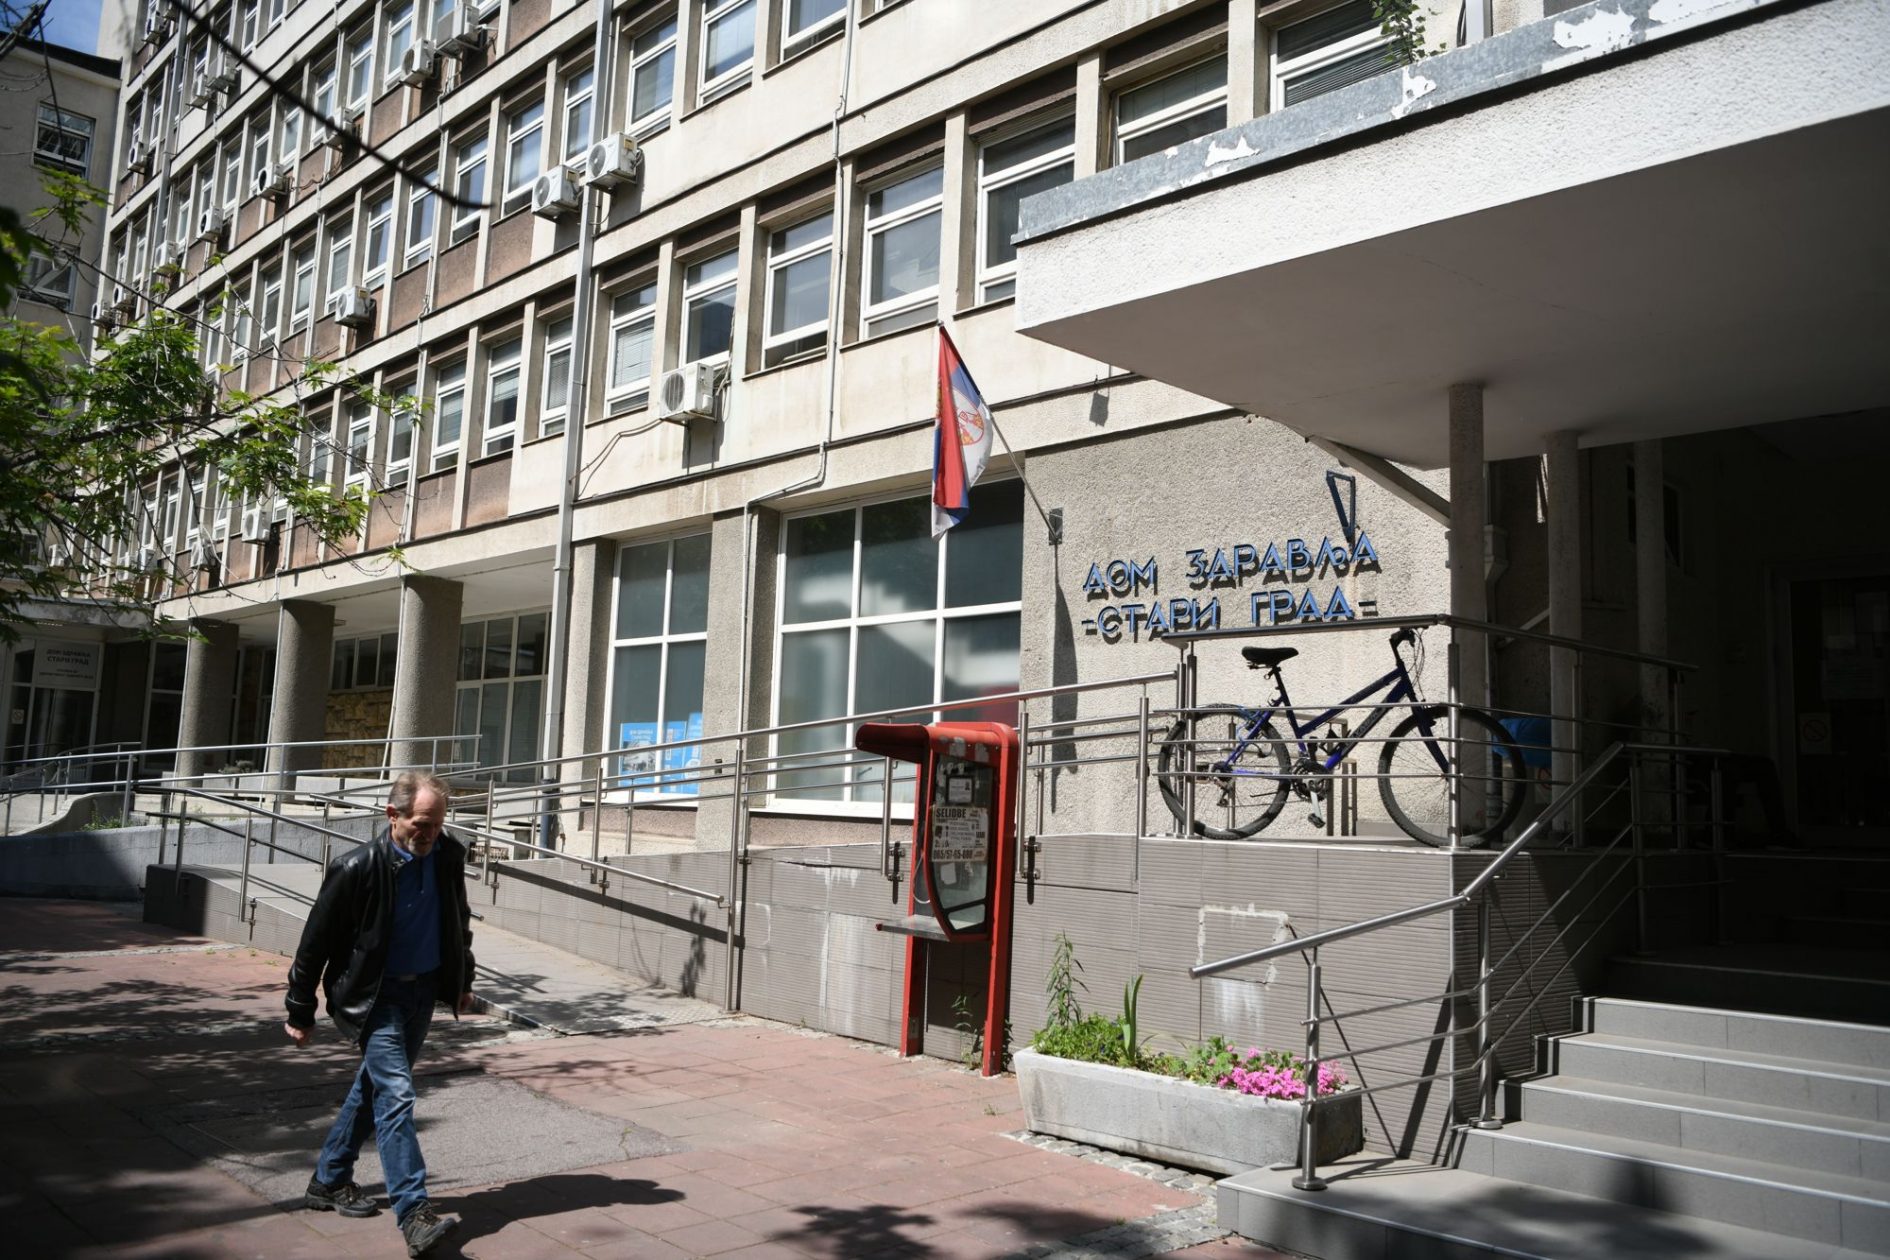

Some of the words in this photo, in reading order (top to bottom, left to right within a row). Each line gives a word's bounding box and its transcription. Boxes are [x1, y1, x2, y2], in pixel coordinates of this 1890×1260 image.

[1082, 556, 1154, 591] ДОМ
[1186, 531, 1378, 579] ЗДРАВЉА
[935, 807, 967, 819] SELIDBE
